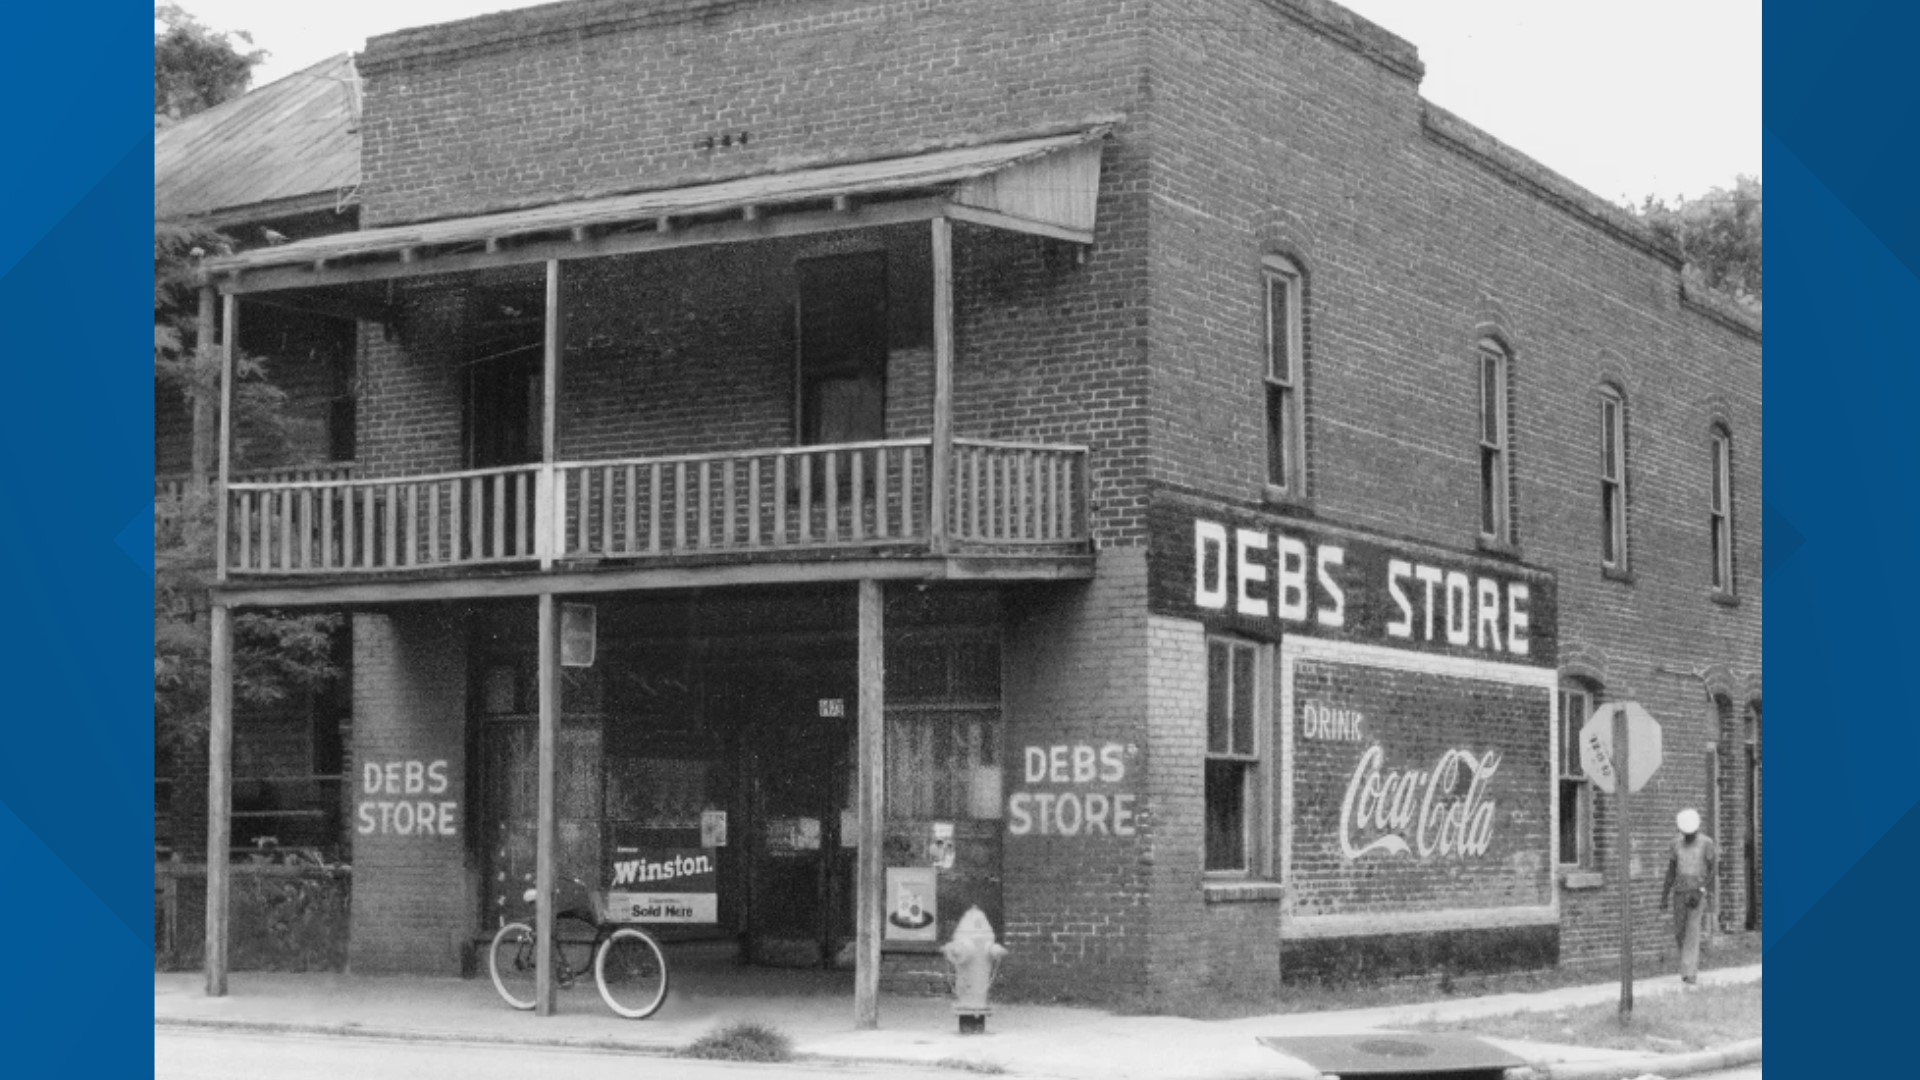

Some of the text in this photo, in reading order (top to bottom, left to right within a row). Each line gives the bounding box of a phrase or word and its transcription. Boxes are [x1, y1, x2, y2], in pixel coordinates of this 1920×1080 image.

[1194, 519, 1530, 655] DEBS STORE
[1303, 703, 1363, 741] DRINK
[363, 760, 449, 794] DEBS
[357, 801, 458, 835] STORE
[1008, 792, 1136, 836] STORE
[632, 904, 694, 918] Sold Here
